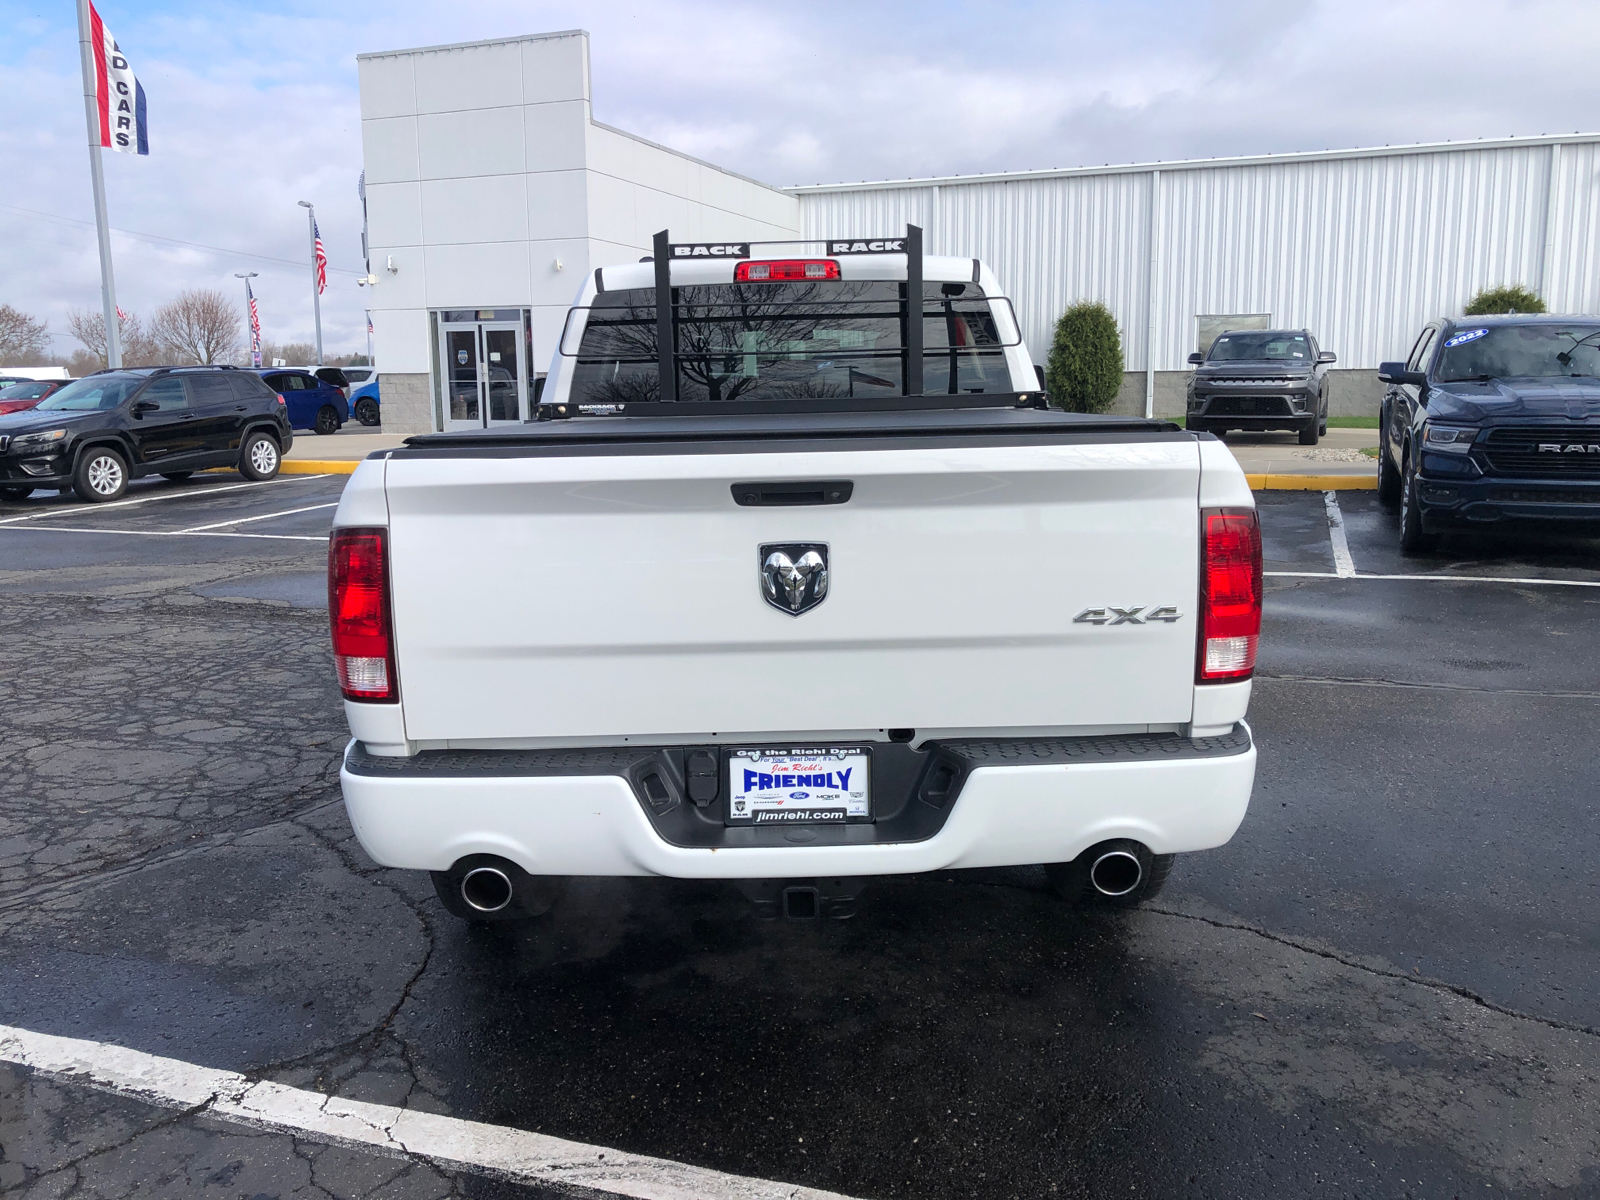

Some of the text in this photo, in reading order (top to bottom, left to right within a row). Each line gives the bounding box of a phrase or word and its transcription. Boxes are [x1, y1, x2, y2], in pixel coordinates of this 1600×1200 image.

[115, 81, 131, 147] CARS
[673, 245, 743, 256] BACK
[832, 241, 902, 253] RACK
[1450, 330, 1484, 346] 2022
[791, 748, 826, 756] Riehl
[770, 763, 823, 774] Jim Riehl's
[743, 766, 853, 793] FRIENDLY
[756, 810, 844, 822] jimriehl.com
